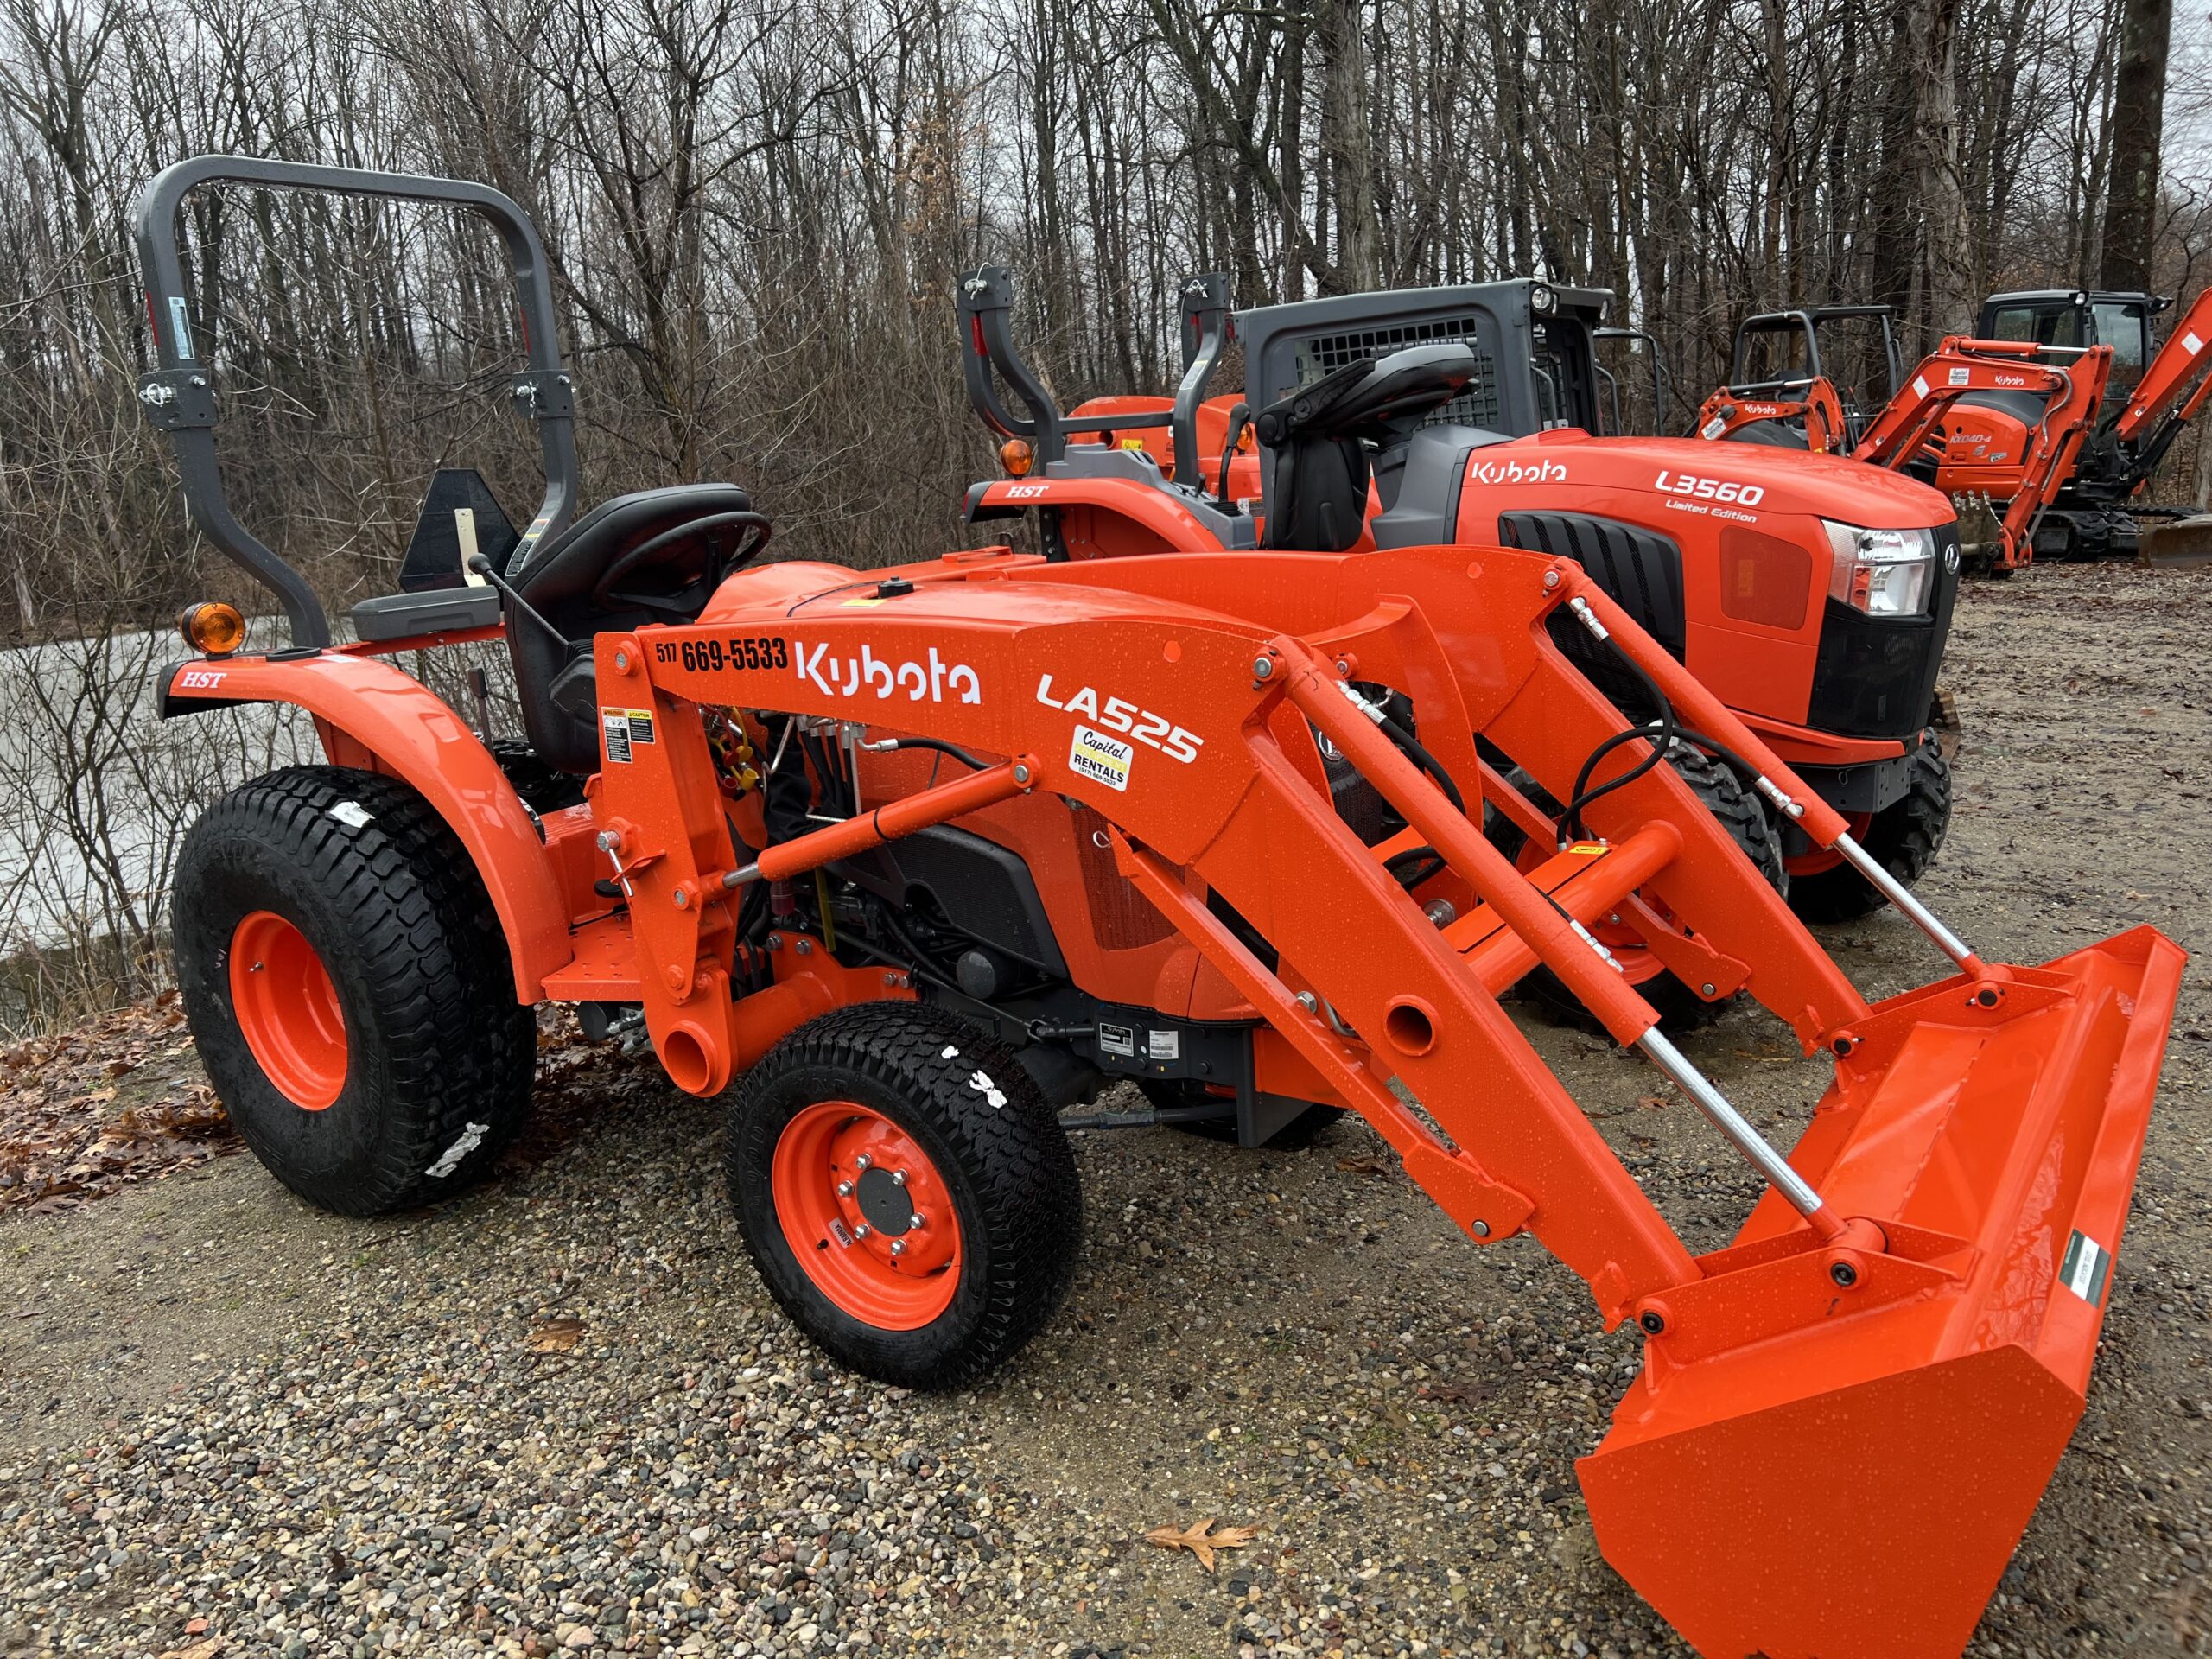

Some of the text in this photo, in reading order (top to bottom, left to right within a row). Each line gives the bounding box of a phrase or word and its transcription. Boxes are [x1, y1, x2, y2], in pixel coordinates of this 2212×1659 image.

[1994, 375, 2024, 386] Kubota
[1745, 404, 1777, 415] Kubota
[1471, 458, 1567, 484] Kubota
[1005, 486, 1050, 499] HST
[1655, 470, 1764, 506] L3560
[1665, 499, 1758, 524] Limited Edition
[655, 637, 789, 672] 517 669-5533
[181, 671, 227, 689] HST
[794, 641, 982, 706] Kubota
[1036, 673, 1205, 764] LA525
[1083, 731, 1128, 760] Capital
[1074, 753, 1124, 783] RENTALS
[1078, 766, 1092, 777] (517)
